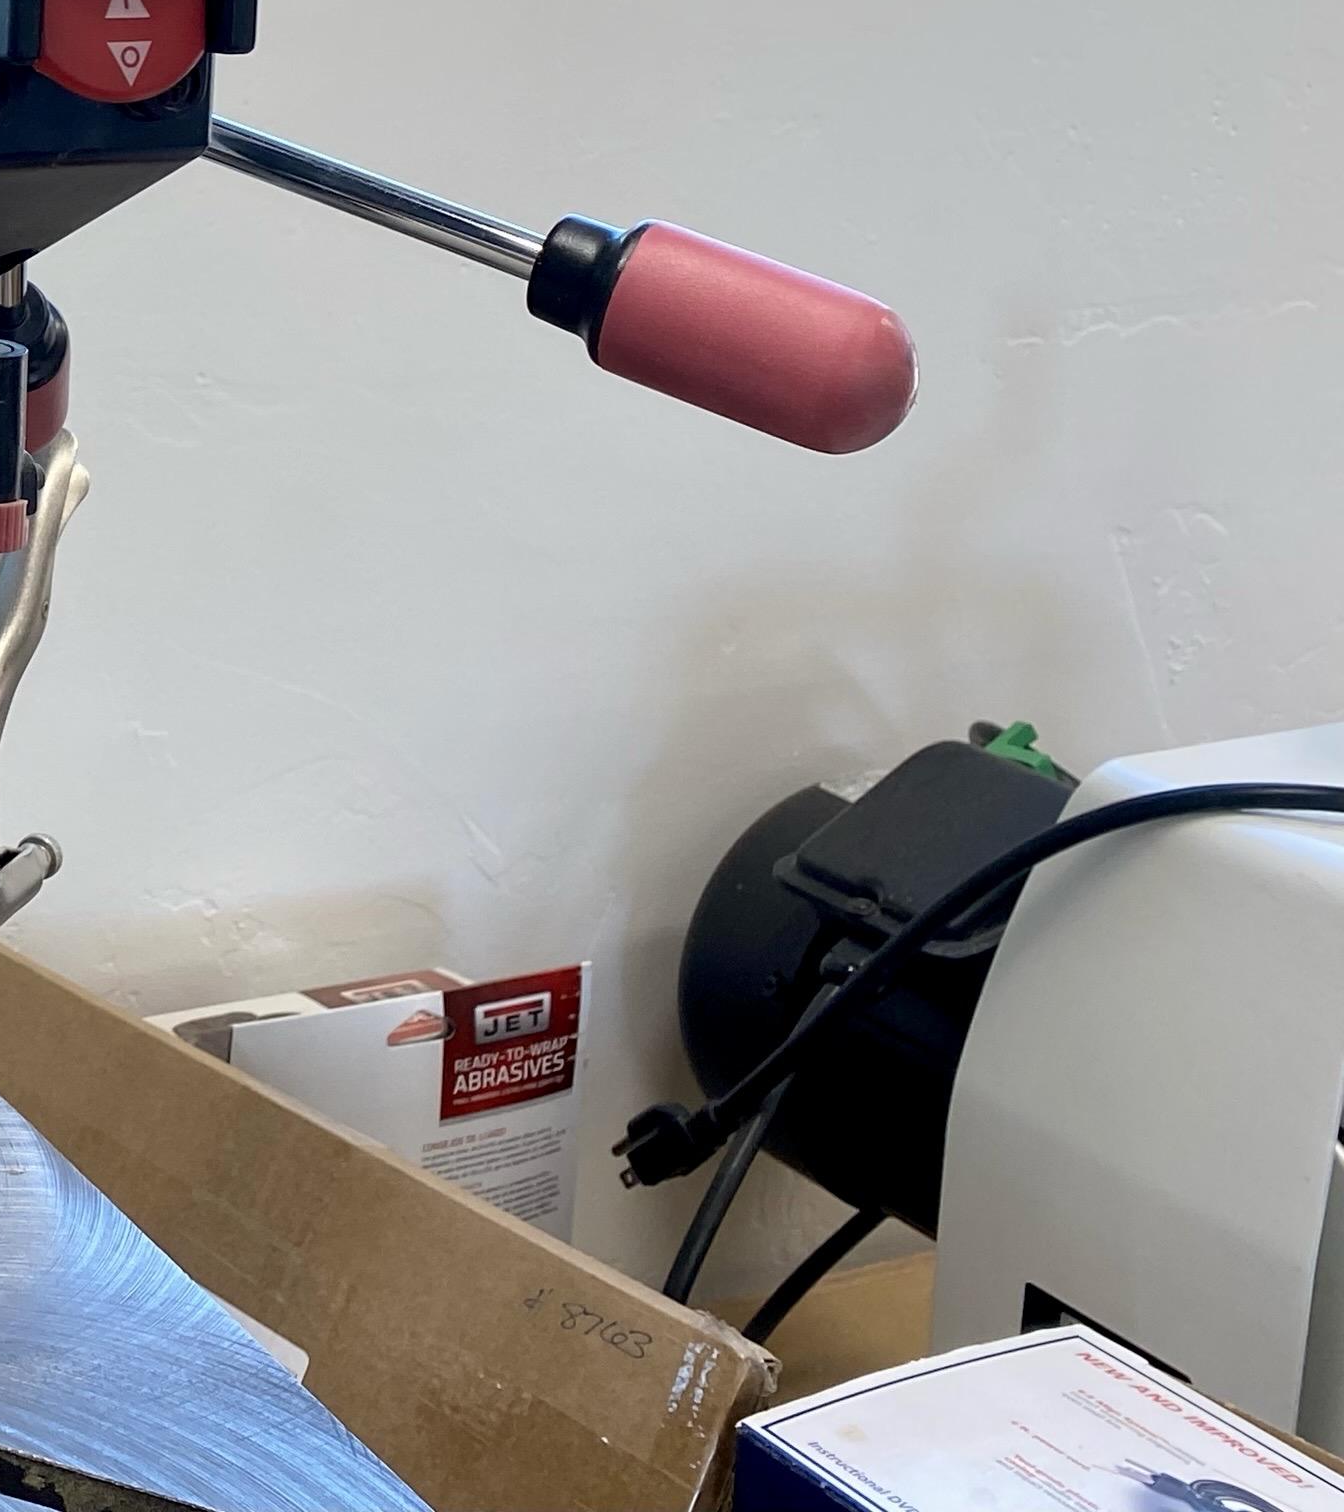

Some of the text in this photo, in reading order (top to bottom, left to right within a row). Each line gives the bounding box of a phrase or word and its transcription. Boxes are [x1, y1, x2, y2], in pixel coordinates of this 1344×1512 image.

[484, 1008, 544, 1037] JET
[452, 1051, 565, 1095] ABRASIVES
[454, 1036, 568, 1074] READY-TO-WRAP
[560, 1302, 653, 1359] 8763
[1076, 1351, 1316, 1489] NEW AND IMPROVED!
[807, 1441, 892, 1495] Instructional
